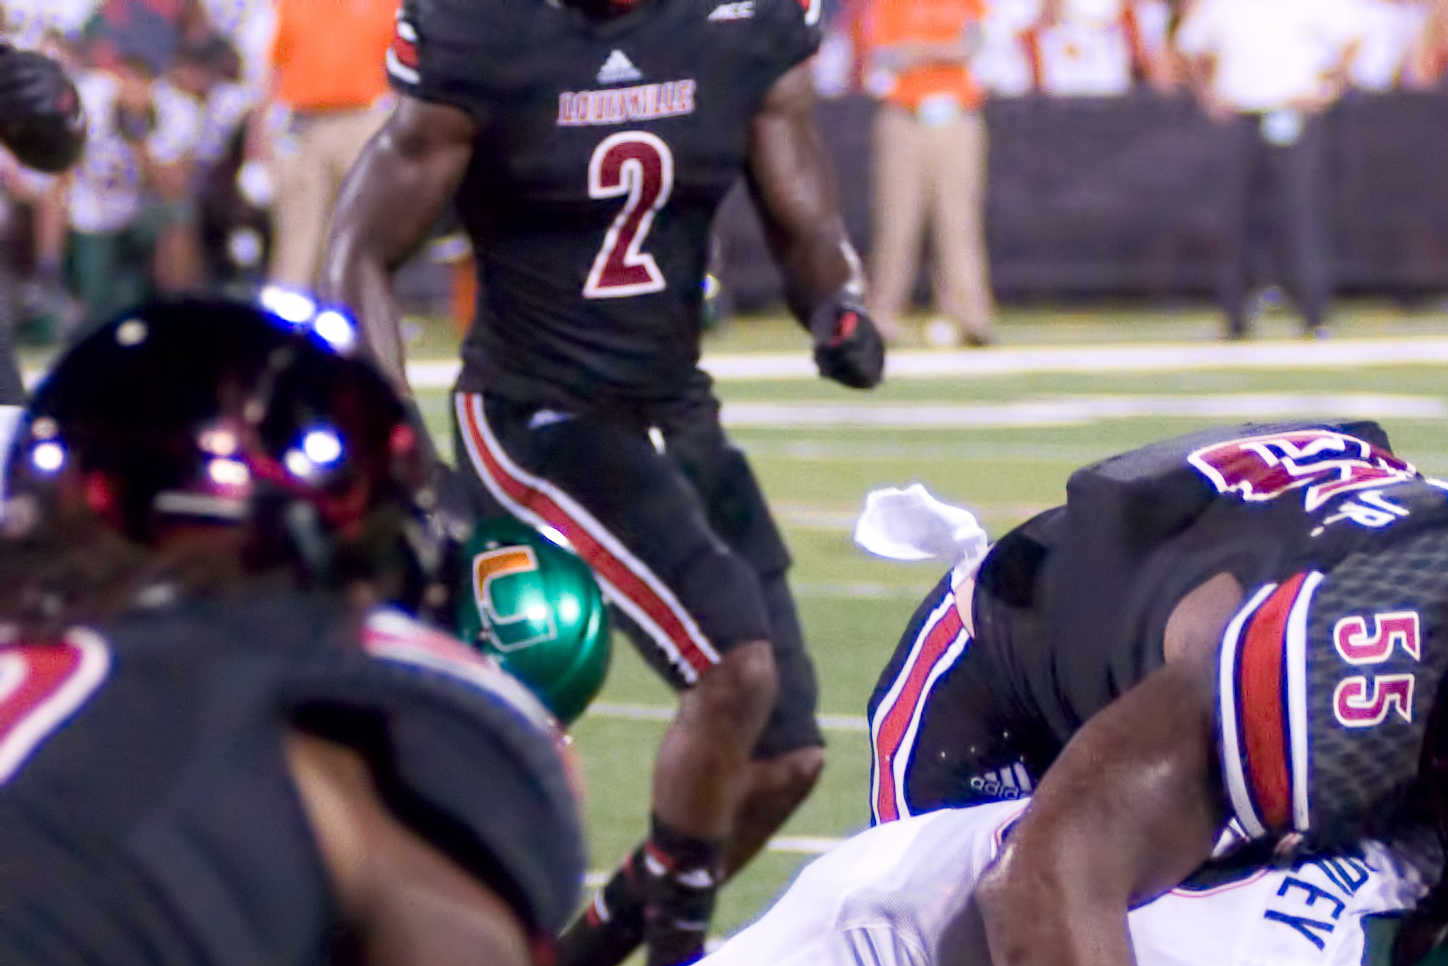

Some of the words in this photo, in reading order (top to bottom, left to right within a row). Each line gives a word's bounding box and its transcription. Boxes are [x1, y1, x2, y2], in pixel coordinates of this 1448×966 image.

[557, 79, 696, 126] LOUISVILLE
[582, 131, 673, 298] 2
[1333, 610, 1421, 728] 55
